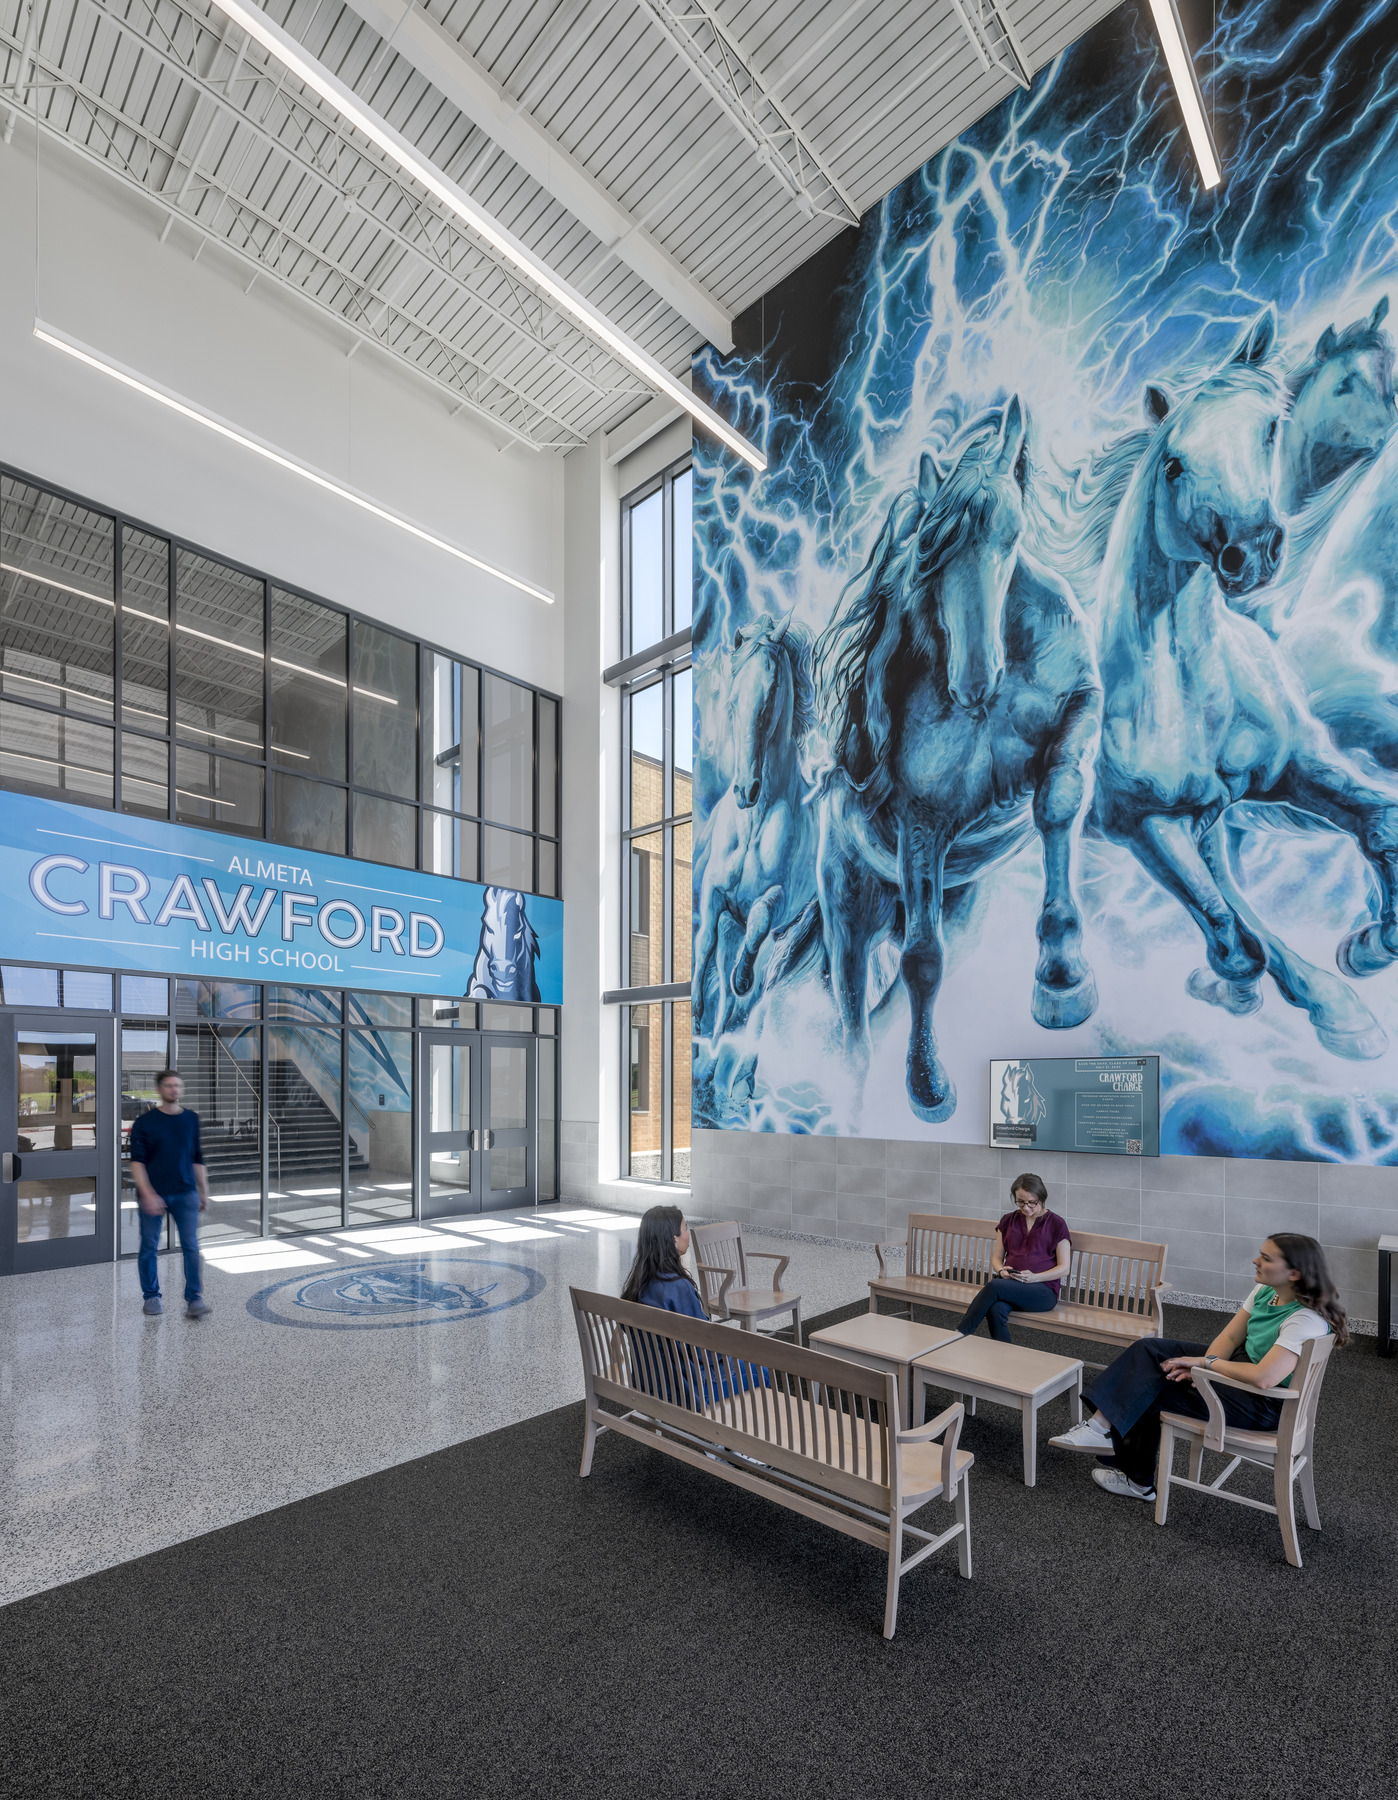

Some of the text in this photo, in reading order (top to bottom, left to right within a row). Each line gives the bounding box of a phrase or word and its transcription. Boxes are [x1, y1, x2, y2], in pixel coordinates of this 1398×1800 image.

[228, 856, 313, 886] ALMETA
[29, 854, 445, 958] CRAWFORD
[191, 939, 344, 972] HIGH SCHOOL
[1099, 1072, 1143, 1083] CRAWFORD
[1112, 1081, 1143, 1092] CHARGE
